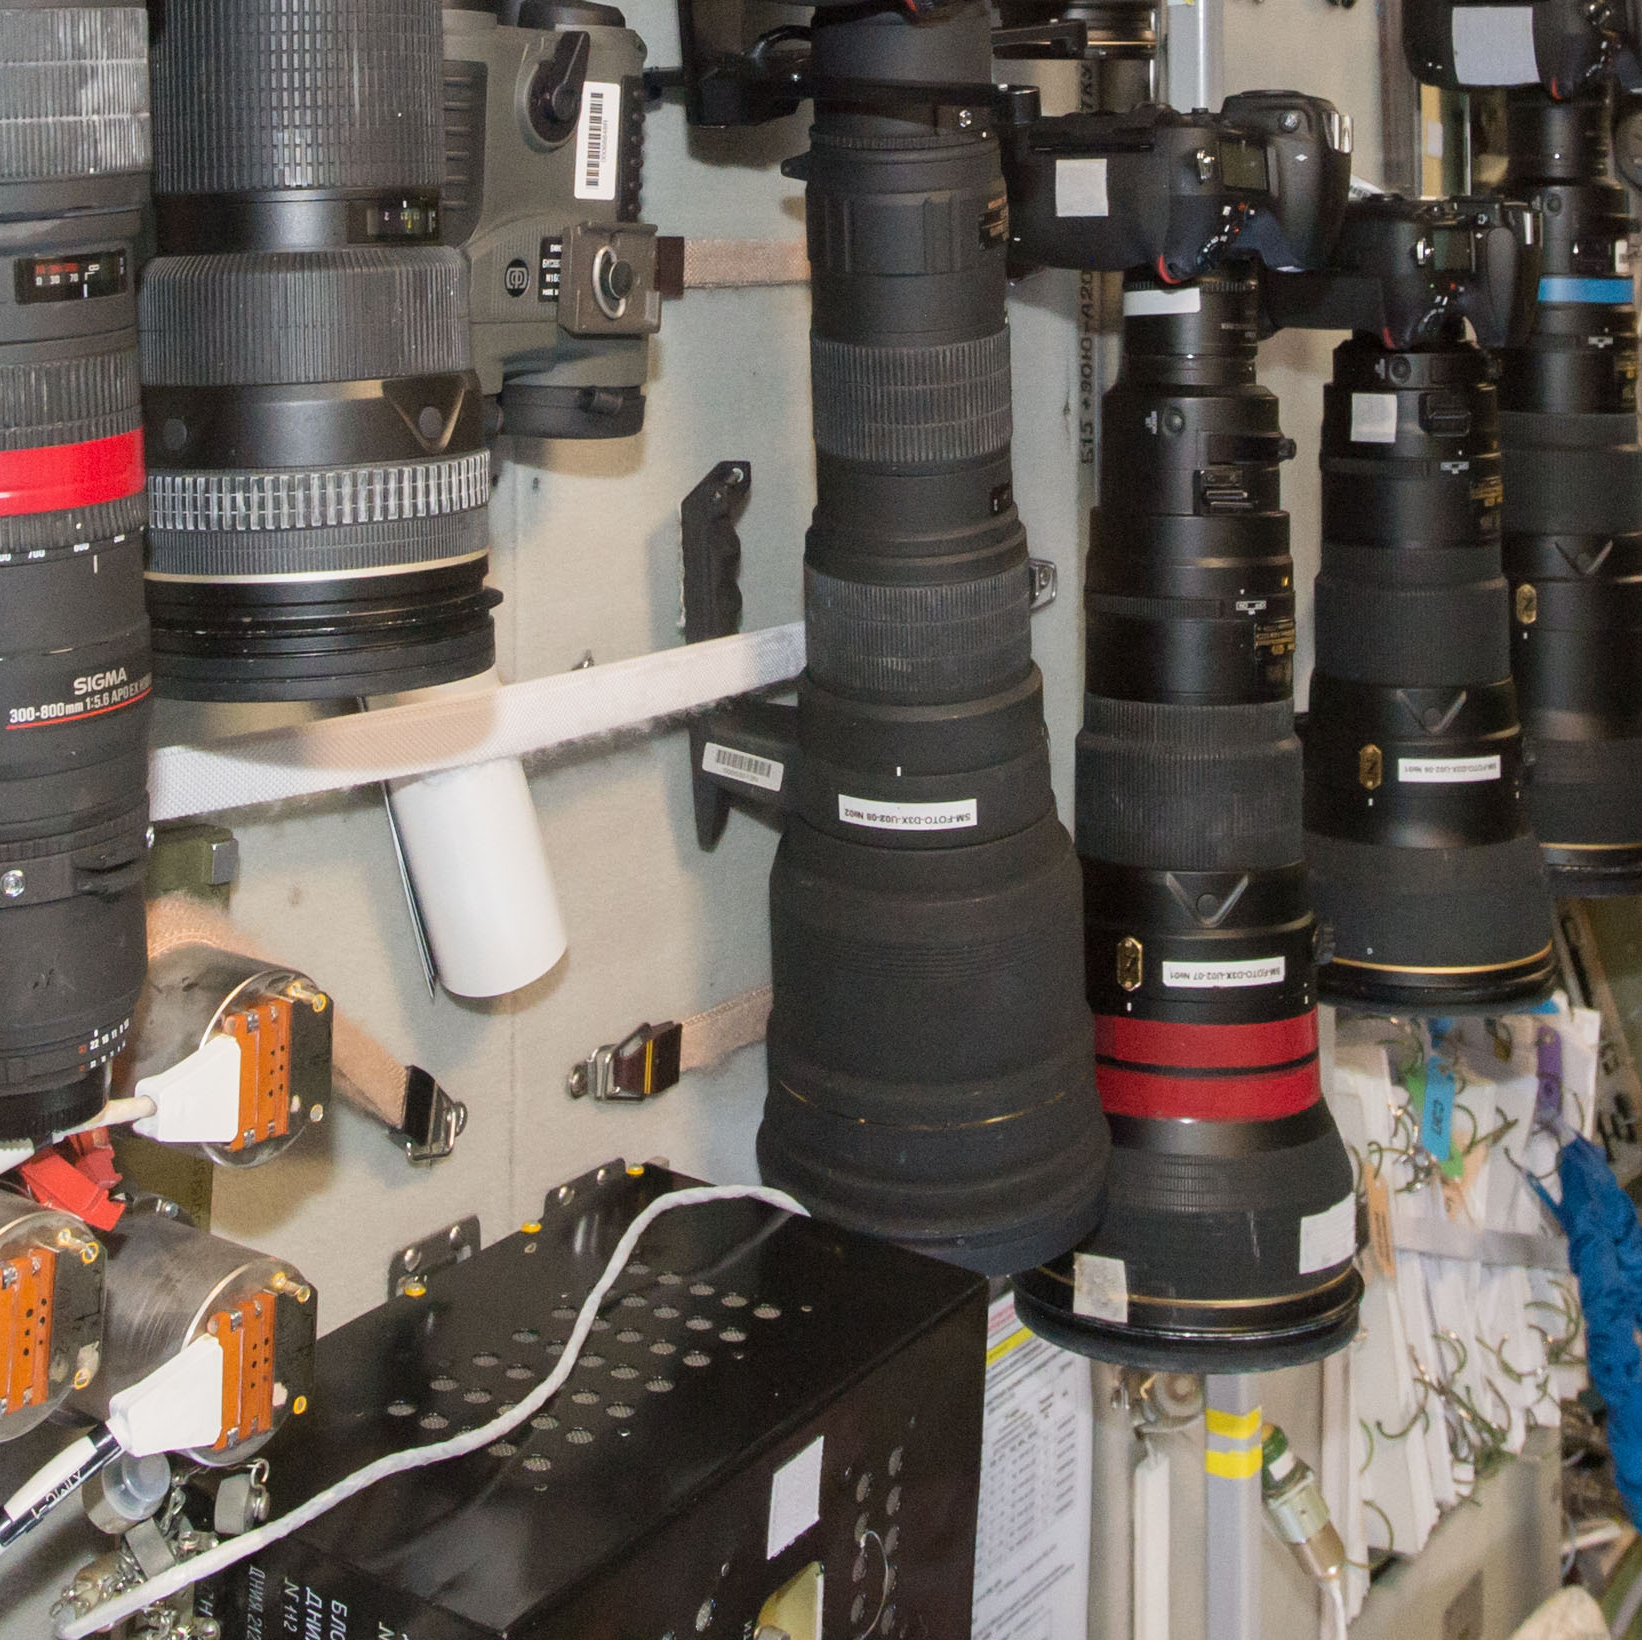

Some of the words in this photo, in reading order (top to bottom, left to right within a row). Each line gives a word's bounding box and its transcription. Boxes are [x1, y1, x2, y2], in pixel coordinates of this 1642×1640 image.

[73, 667, 128, 696] SIGMA
[9, 701, 84, 724] 300-800mm
[85, 695, 110, 710] 1:5.6
[111, 685, 128, 704] APO
[129, 682, 140, 697] EX
[90, 1039, 100, 1050] 22
